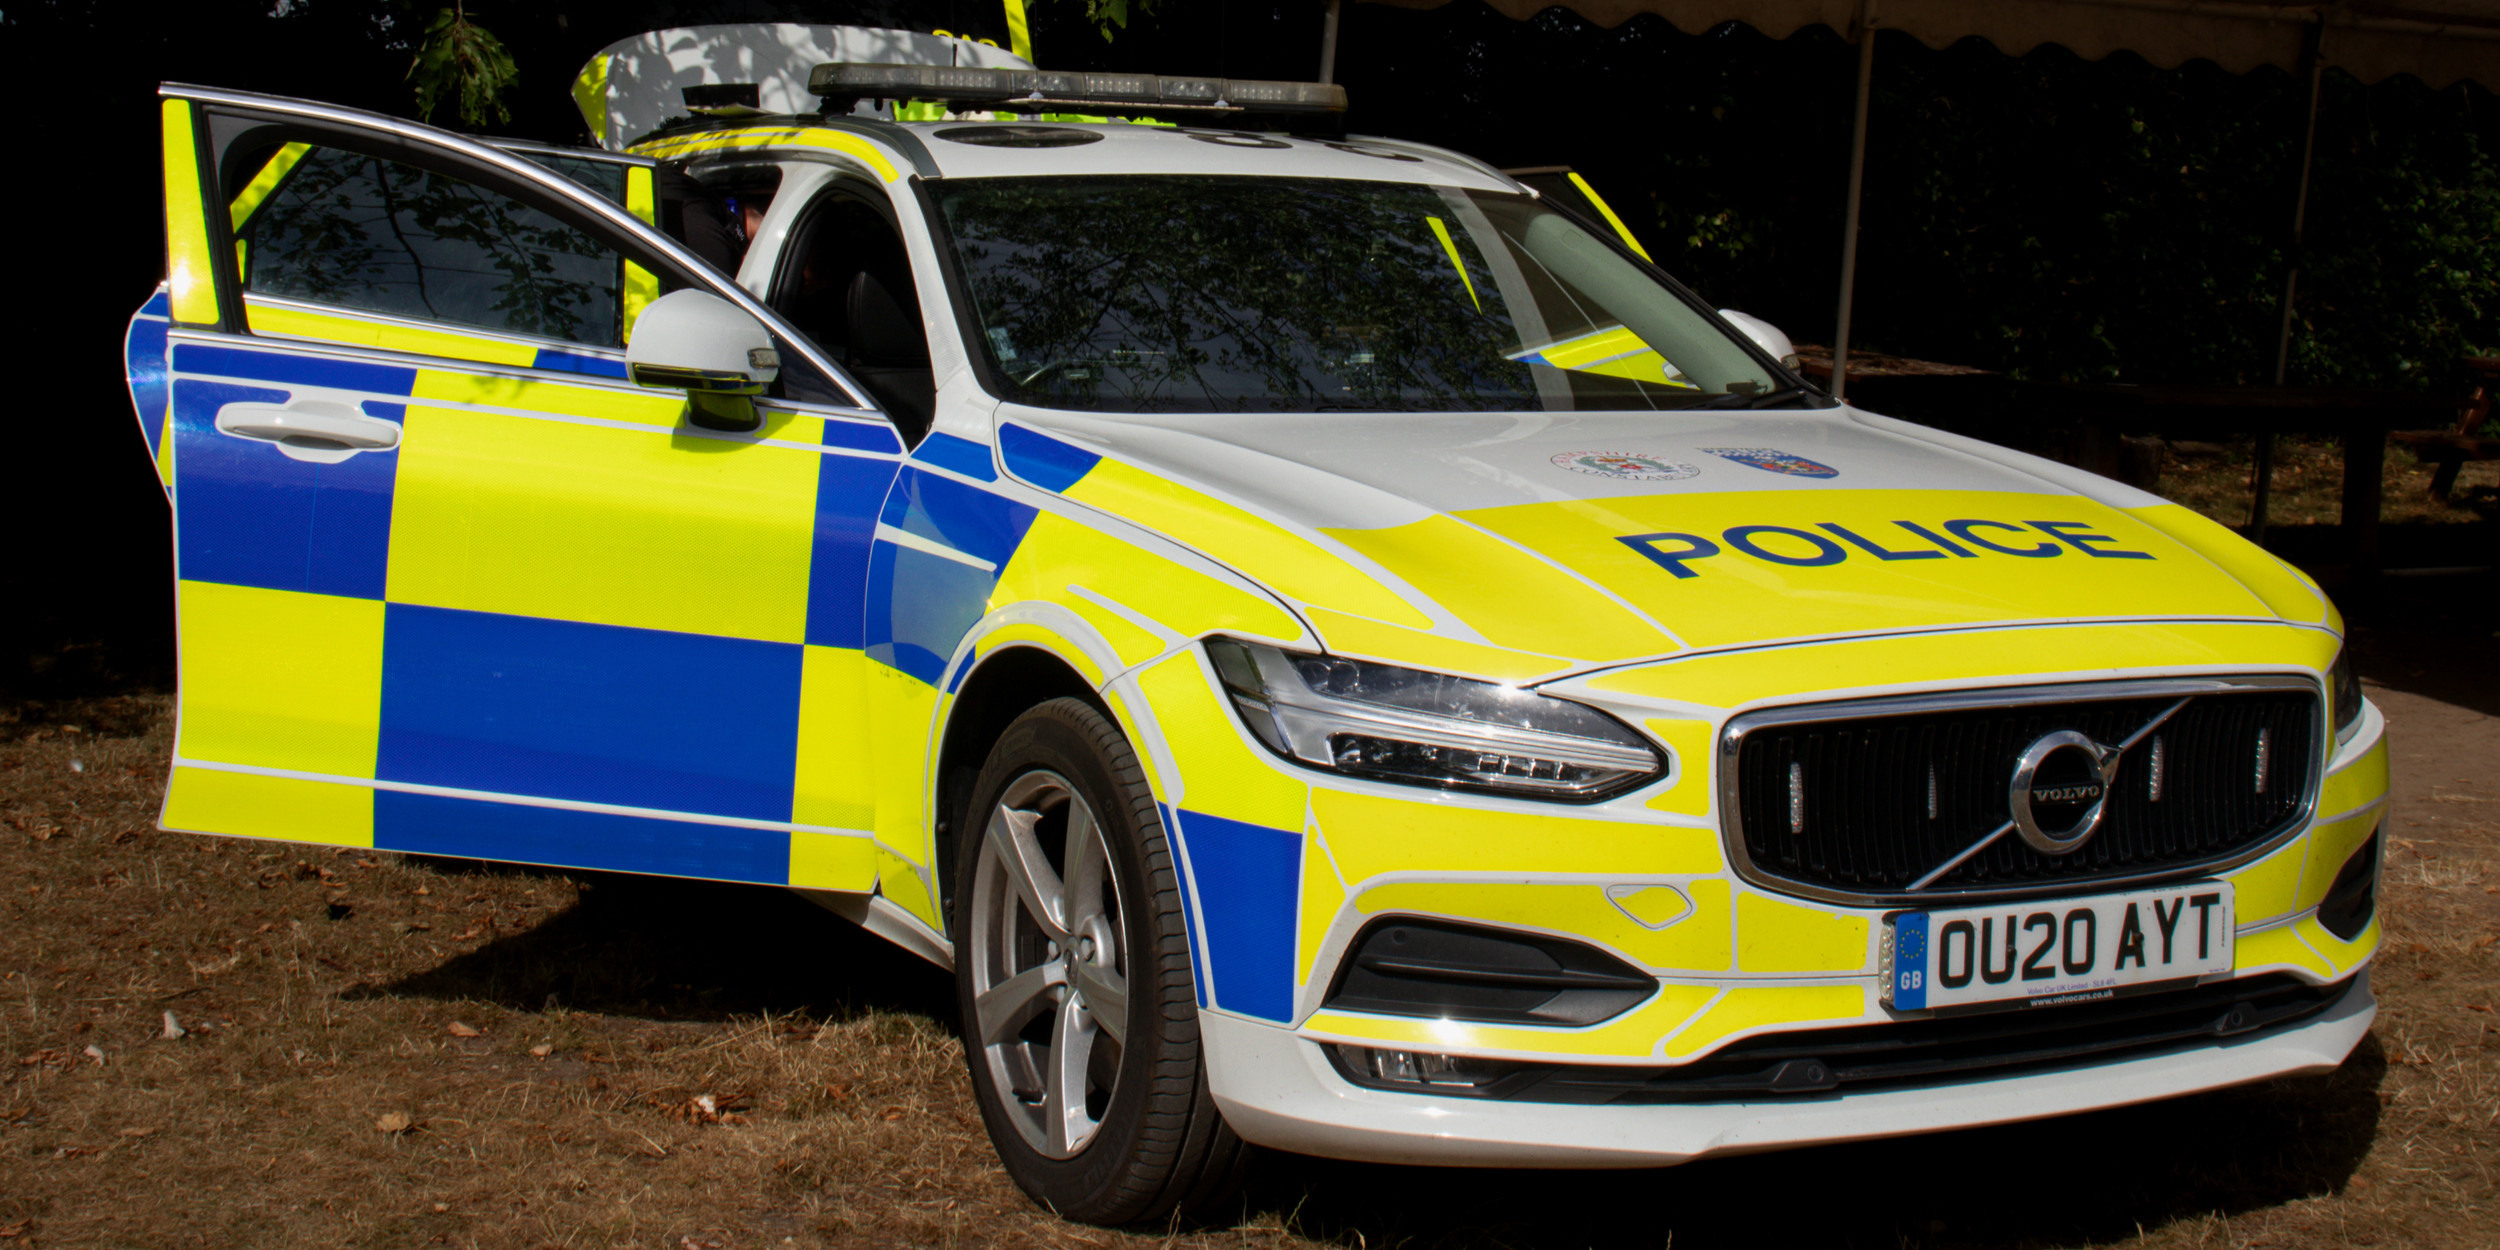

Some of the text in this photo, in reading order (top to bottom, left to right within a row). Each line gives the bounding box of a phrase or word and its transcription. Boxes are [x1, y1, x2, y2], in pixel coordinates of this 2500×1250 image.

[1614, 518, 2158, 580] POLICE
[2033, 785, 2100, 801] VOLVO
[1939, 908, 2096, 989] OU20
[2114, 893, 2220, 971] AYT
[1901, 971, 1922, 990] GB
[2030, 989, 2113, 1006] www.volvocars.co.uk
